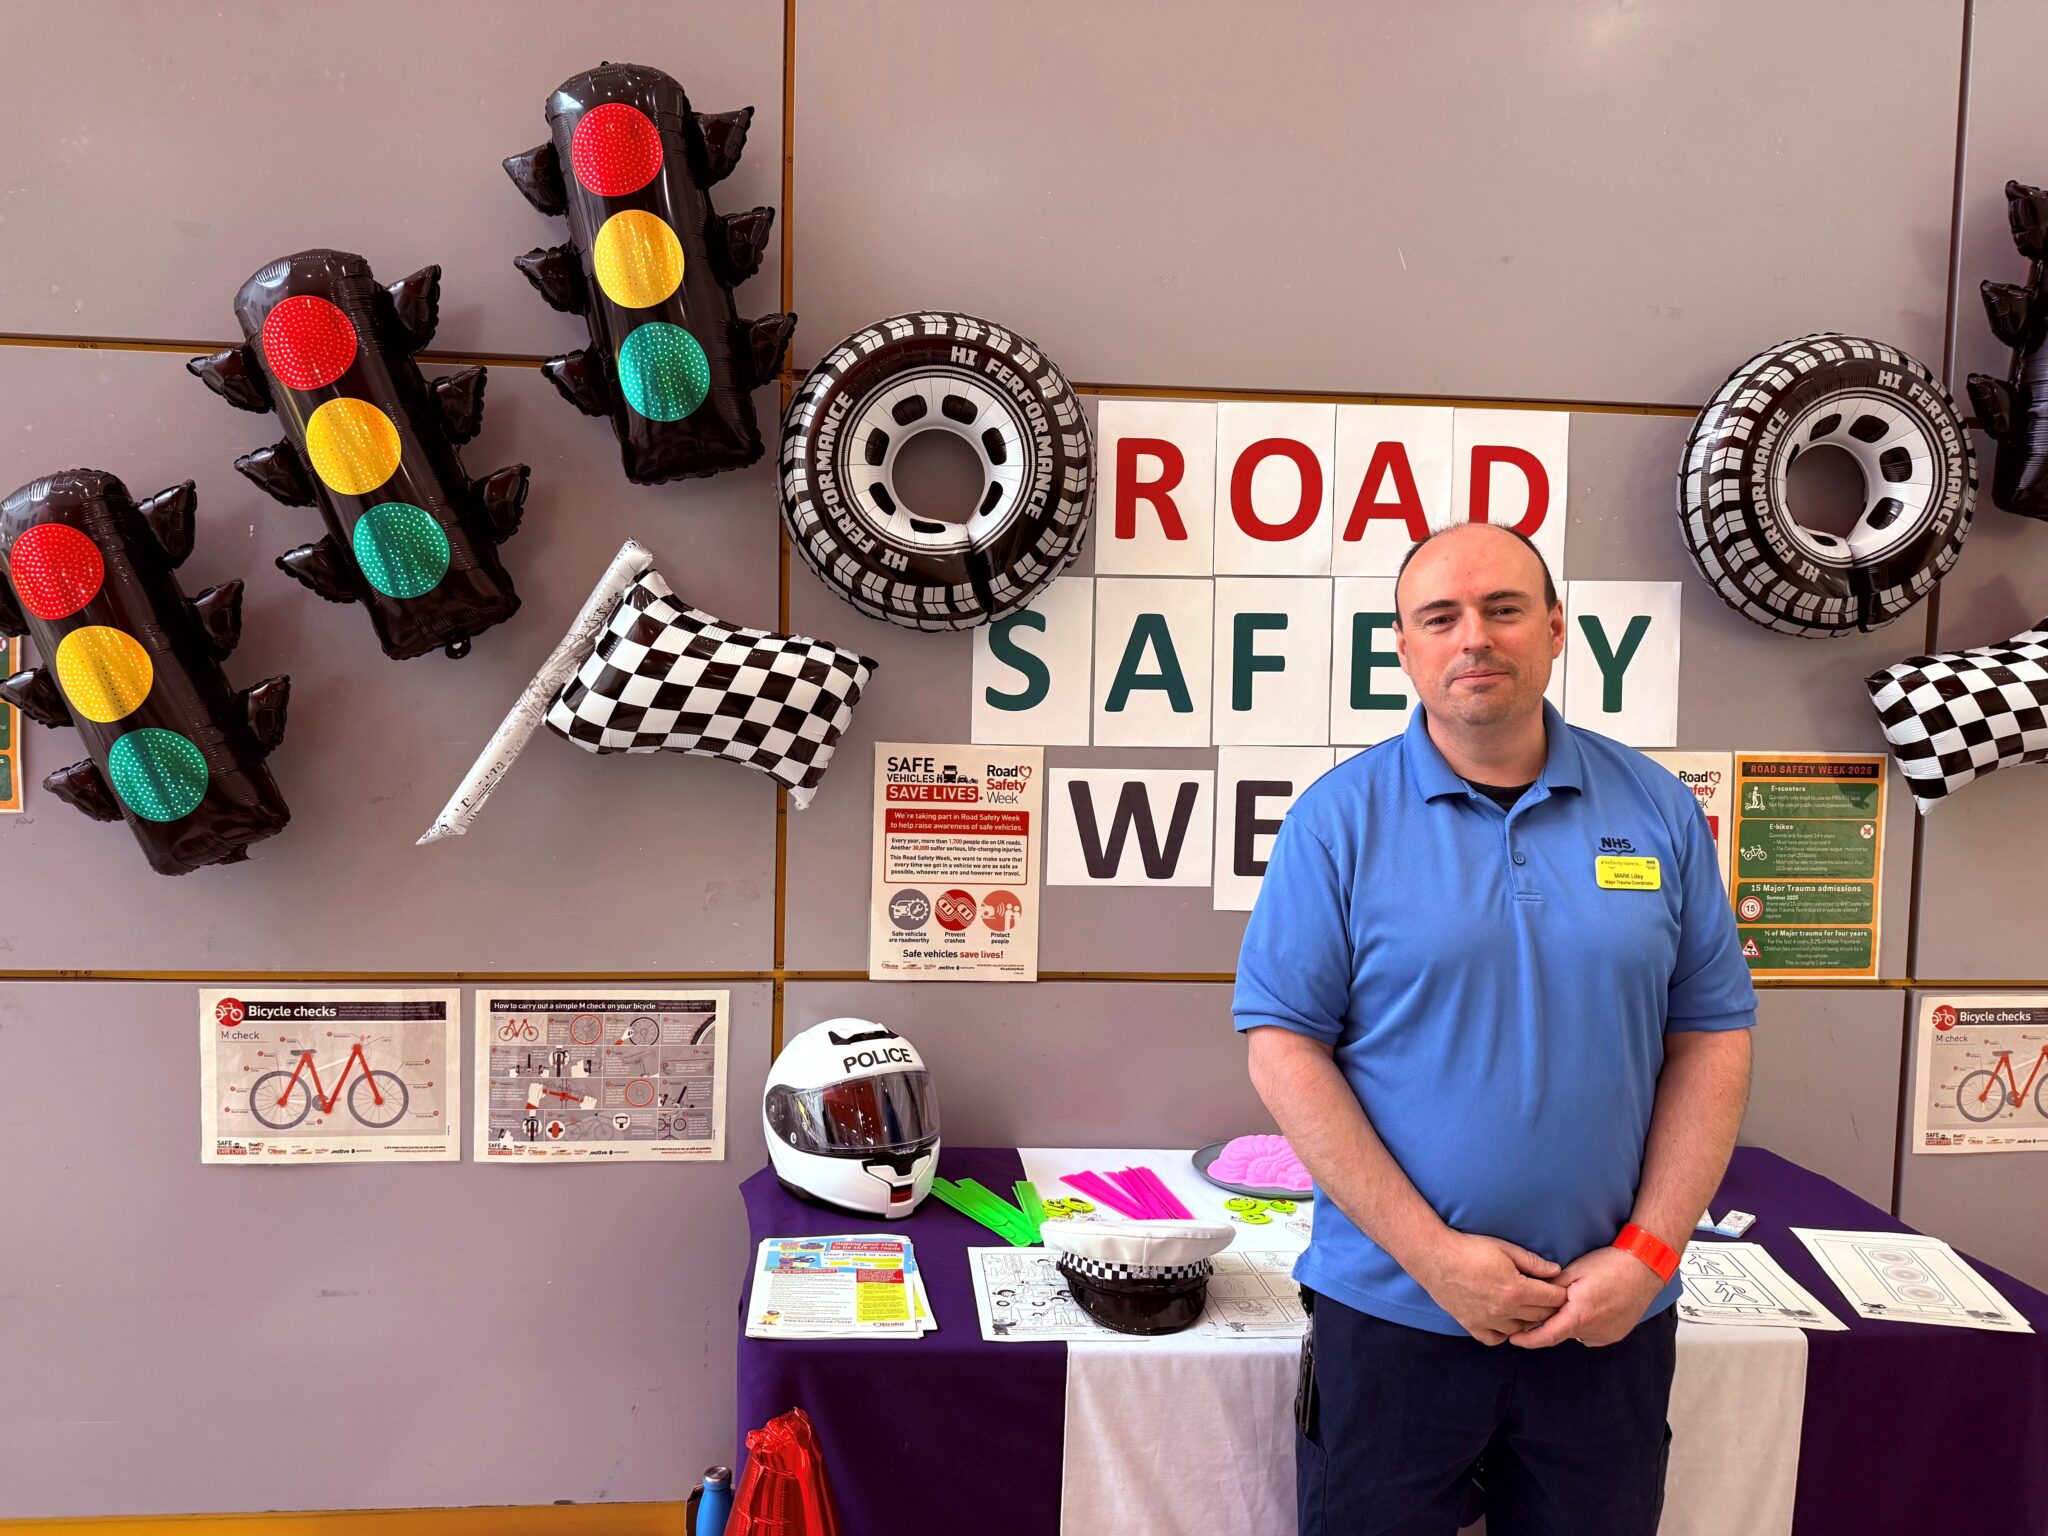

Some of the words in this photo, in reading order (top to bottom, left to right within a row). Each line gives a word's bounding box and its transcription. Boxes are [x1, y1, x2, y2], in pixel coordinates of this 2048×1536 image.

[950, 345, 978, 367] HI
[1877, 370, 1902, 390] HI
[1114, 436, 1550, 542] ROAD
[880, 550, 909, 573] HI
[1796, 558, 1821, 583] HI
[985, 610, 1652, 713] SAFEY
[887, 757, 935, 772] SAFE
[1780, 765, 1815, 774] SAFETY
[1818, 766, 1845, 774] WEEK
[986, 765, 1018, 777] Road
[1678, 770, 1708, 782] Road
[887, 774, 935, 783] VEHICLES
[986, 778, 1026, 793] Safety
[889, 786, 928, 800] SAVE
[987, 792, 1019, 804] Week
[916, 812, 936, 820] taking
[938, 812, 952, 820] part
[961, 812, 978, 820] Road
[979, 812, 1000, 822] Safety
[1600, 837, 1632, 849] NHS
[1763, 885, 1784, 893] Major
[903, 949, 922, 958] Safe
[924, 950, 958, 958] vehicles
[981, 950, 1003, 959] lives!
[634, 1002, 656, 1011] bicycle
[248, 1006, 292, 1020] Bicycle
[294, 1006, 337, 1017] checks
[1960, 1012, 1994, 1023] Bicycle
[1997, 1012, 2031, 1021] checks
[221, 1031, 230, 1040] M
[232, 1031, 260, 1040] check
[842, 1046, 914, 1074] POLICE
